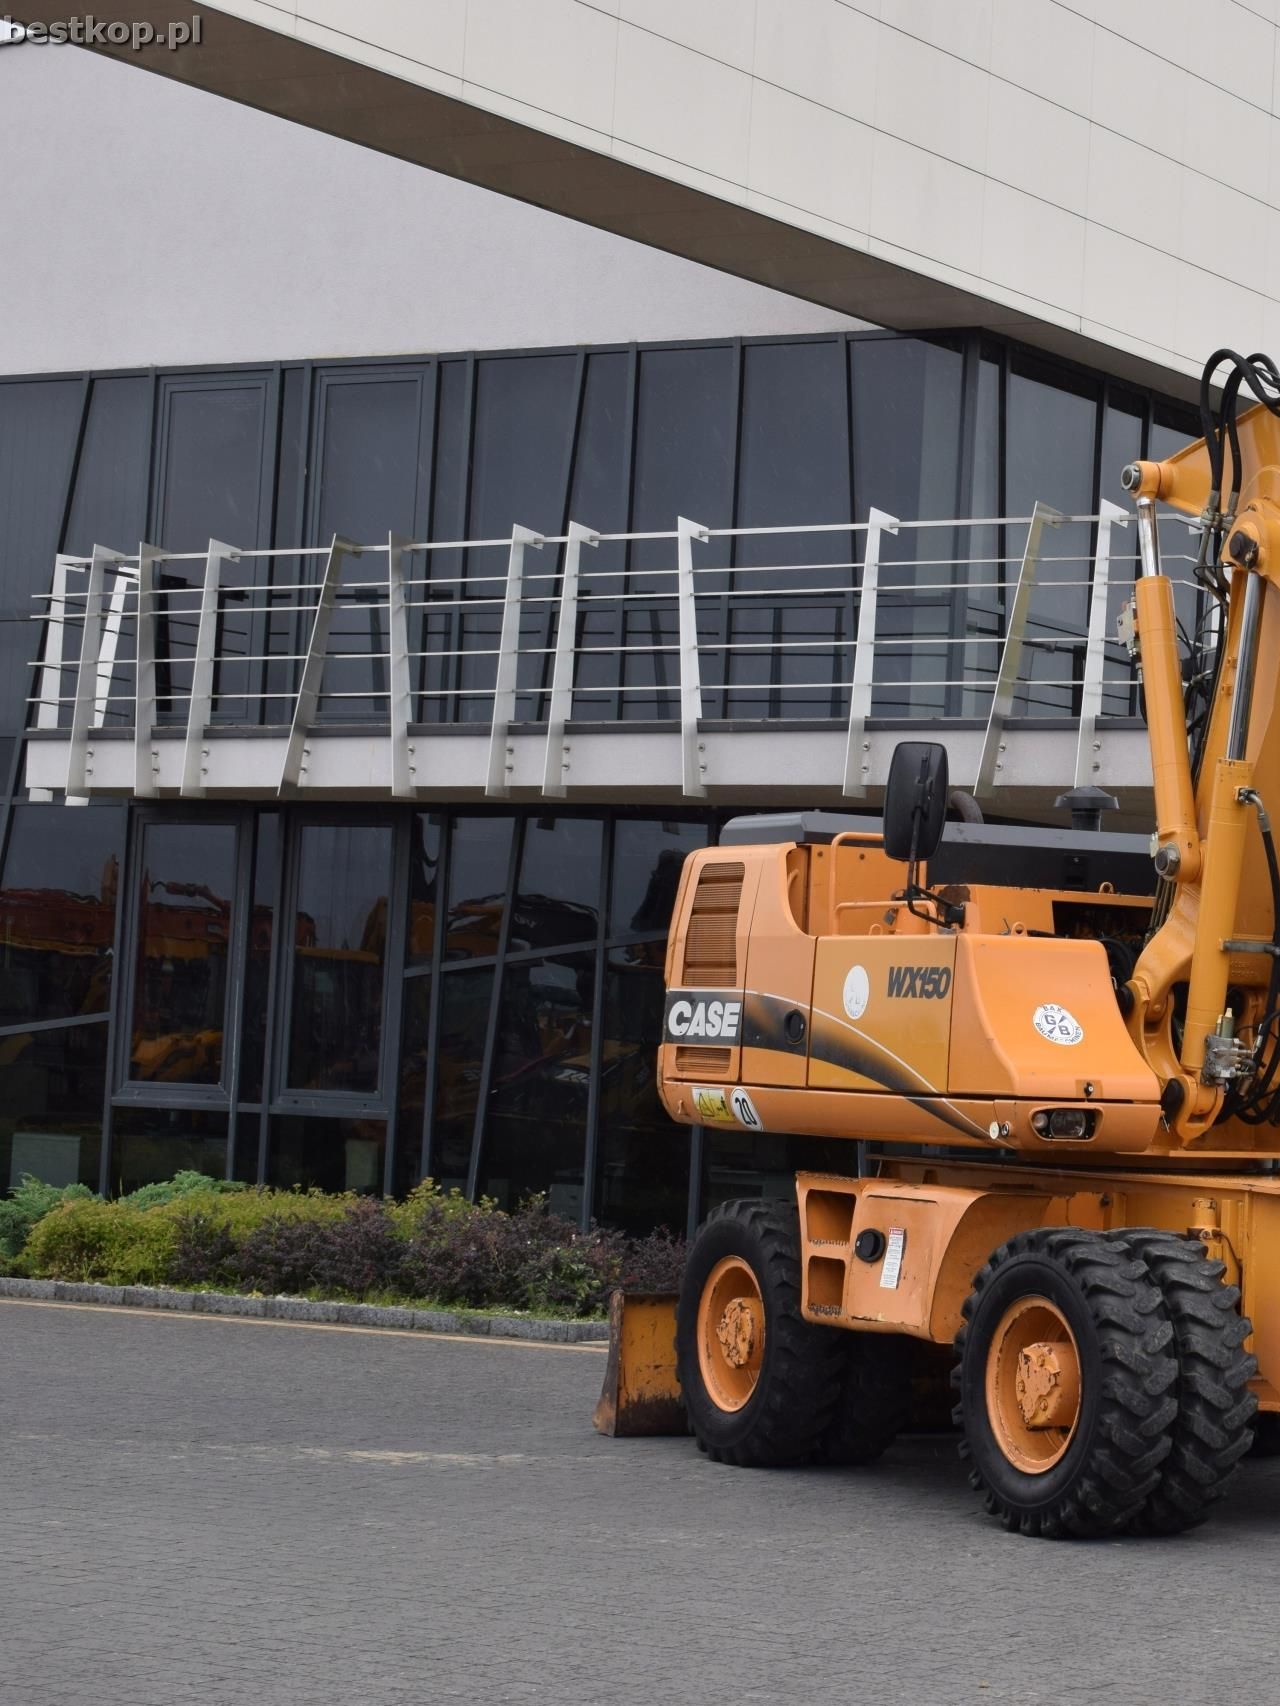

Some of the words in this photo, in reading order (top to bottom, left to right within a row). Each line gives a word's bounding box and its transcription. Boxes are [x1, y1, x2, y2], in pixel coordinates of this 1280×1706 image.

[887, 966, 952, 1000] WX150
[668, 1000, 742, 1038] CASE
[734, 1096, 758, 1126] 20
